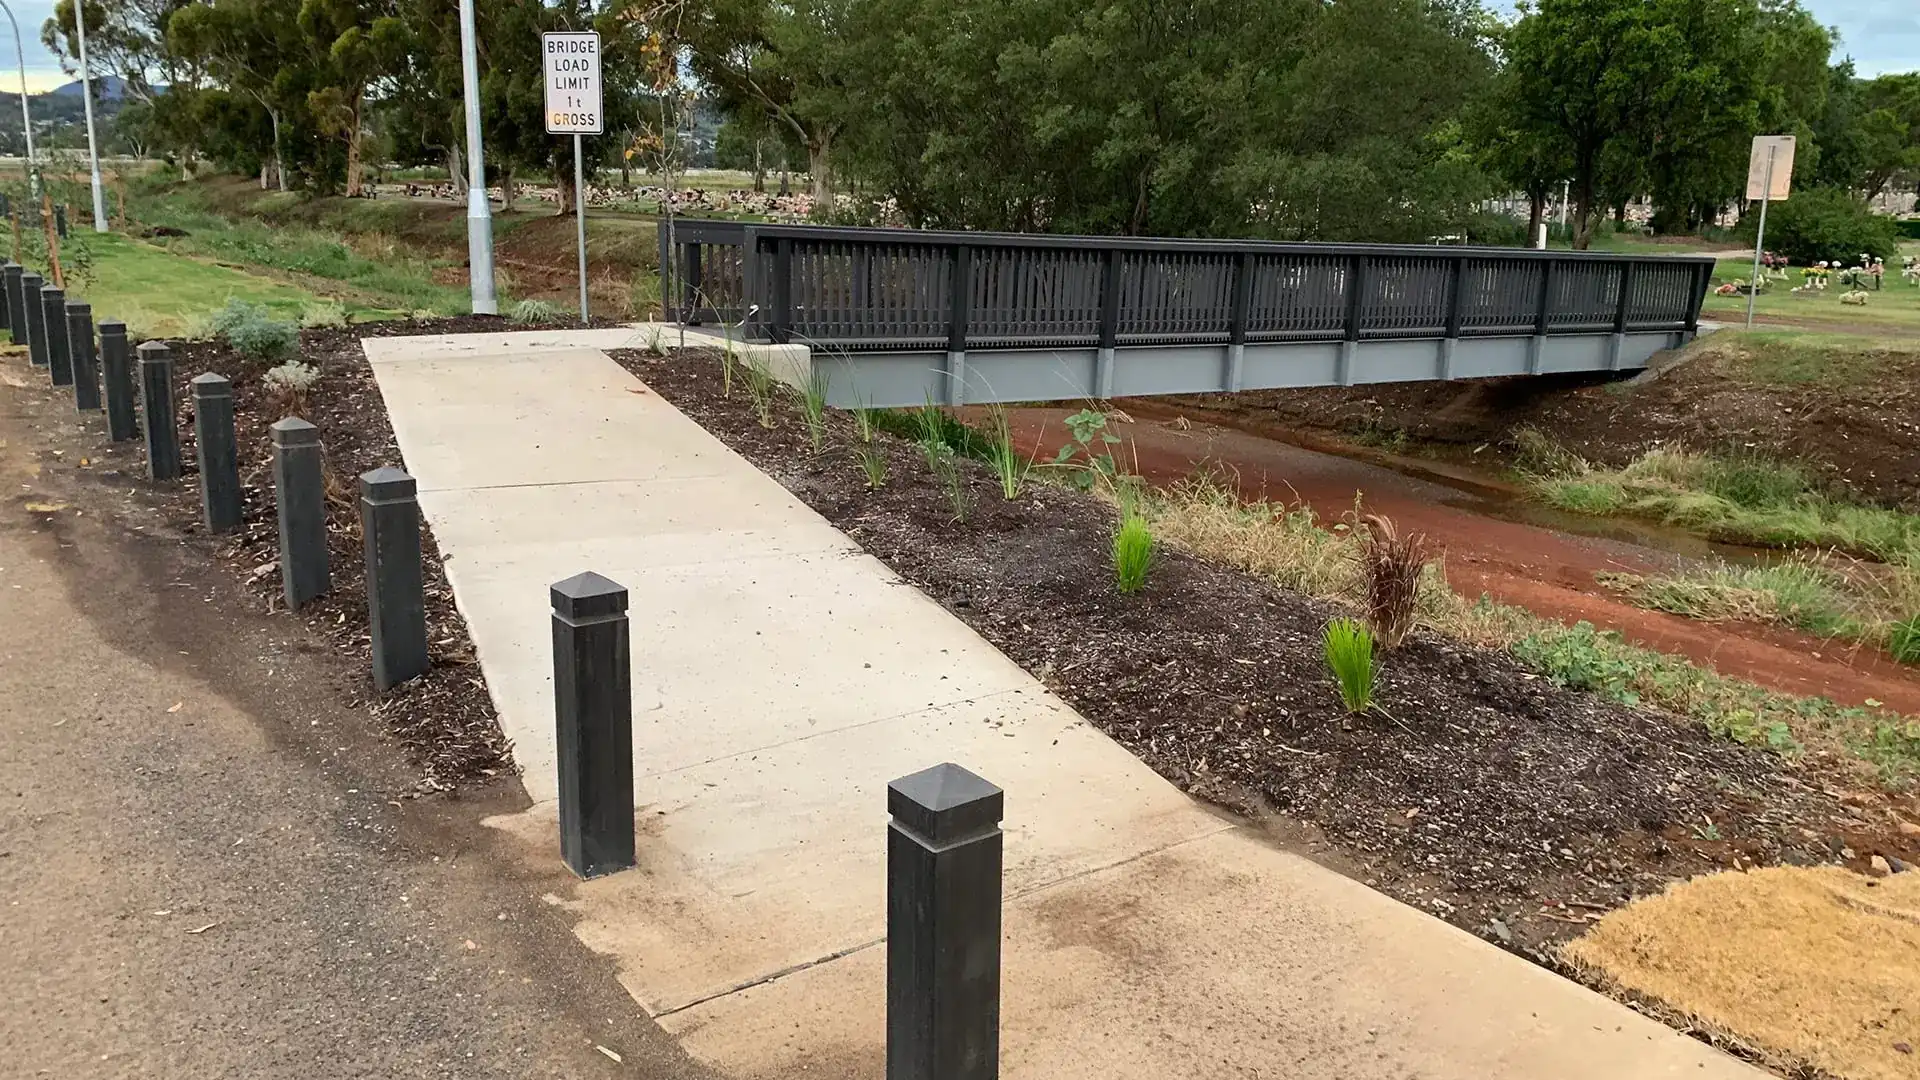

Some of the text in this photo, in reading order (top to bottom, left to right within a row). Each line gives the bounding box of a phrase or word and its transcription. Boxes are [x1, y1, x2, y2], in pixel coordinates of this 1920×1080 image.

[548, 41, 595, 53] BRIDGE
[555, 59, 589, 71] LOAD
[555, 77, 590, 89] LIMIT
[554, 113, 595, 126] GROSS
